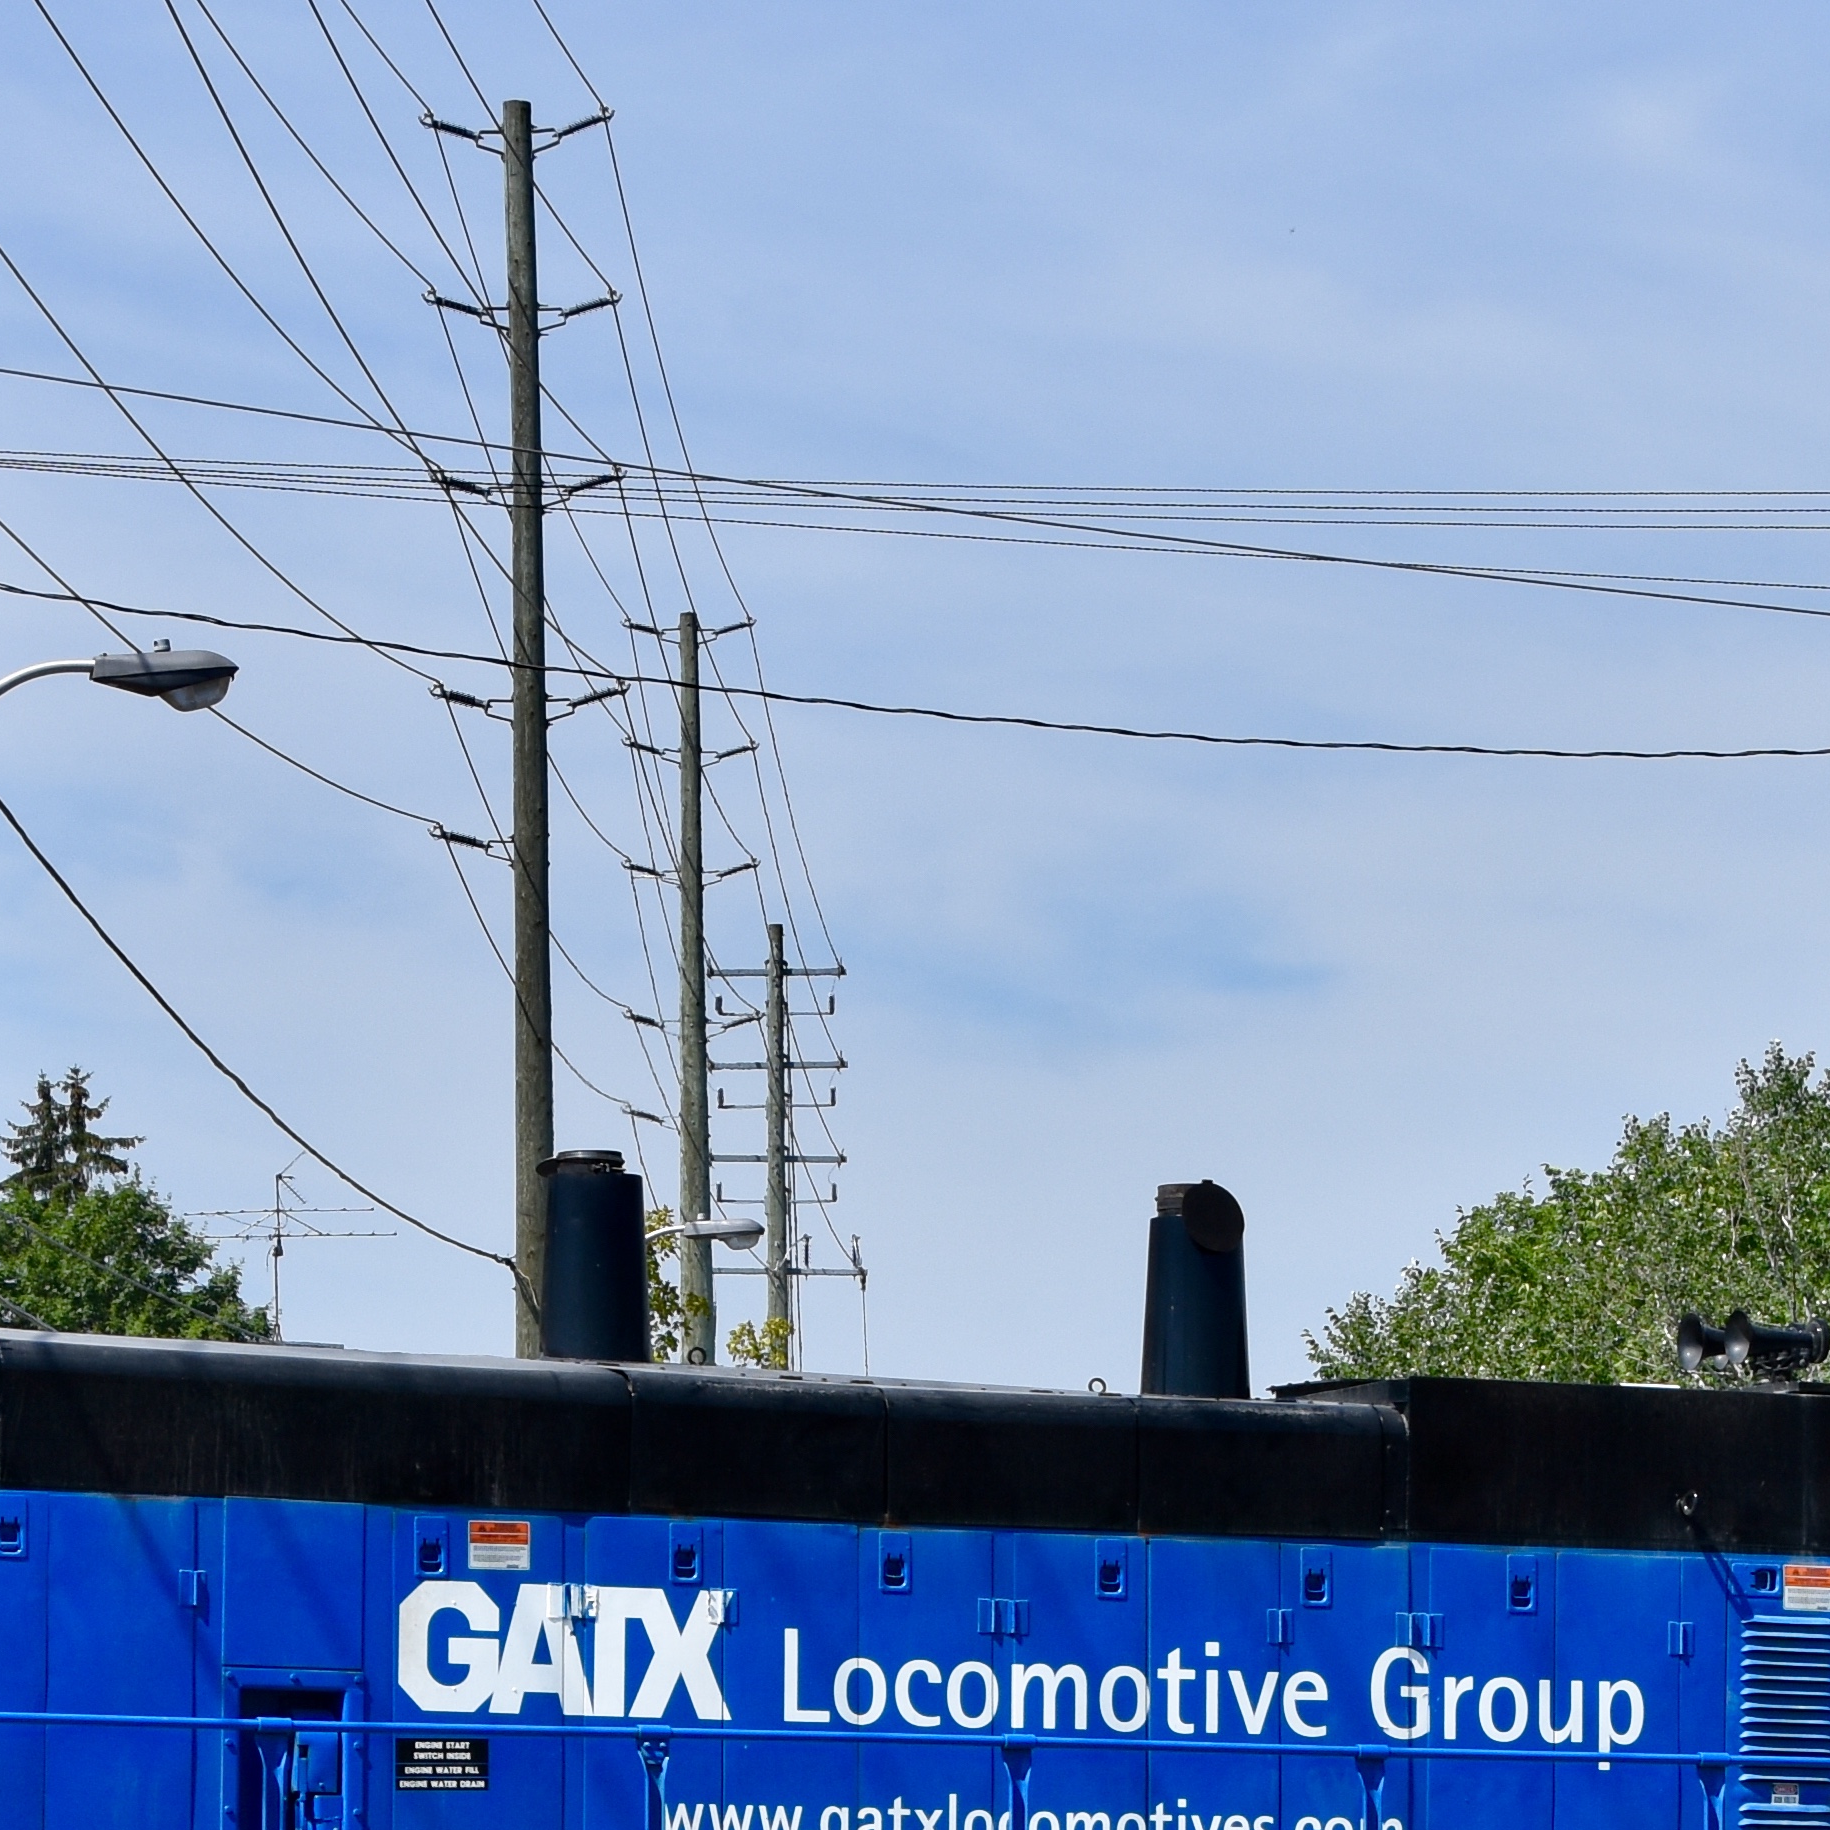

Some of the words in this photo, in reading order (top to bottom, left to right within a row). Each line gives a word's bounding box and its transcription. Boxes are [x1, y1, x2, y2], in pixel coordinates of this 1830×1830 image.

[398, 1580, 733, 1720] GATX
[783, 1628, 1328, 1737] Locomotive
[1371, 1646, 1645, 1771] Group
[446, 1741, 470, 1749] START
[413, 1752, 444, 1760] SWITCH
[435, 1766, 463, 1774] WATER
[465, 1766, 480, 1774] FILL
[430, 1780, 458, 1788] WATER
[459, 1780, 485, 1788] DRAIN
